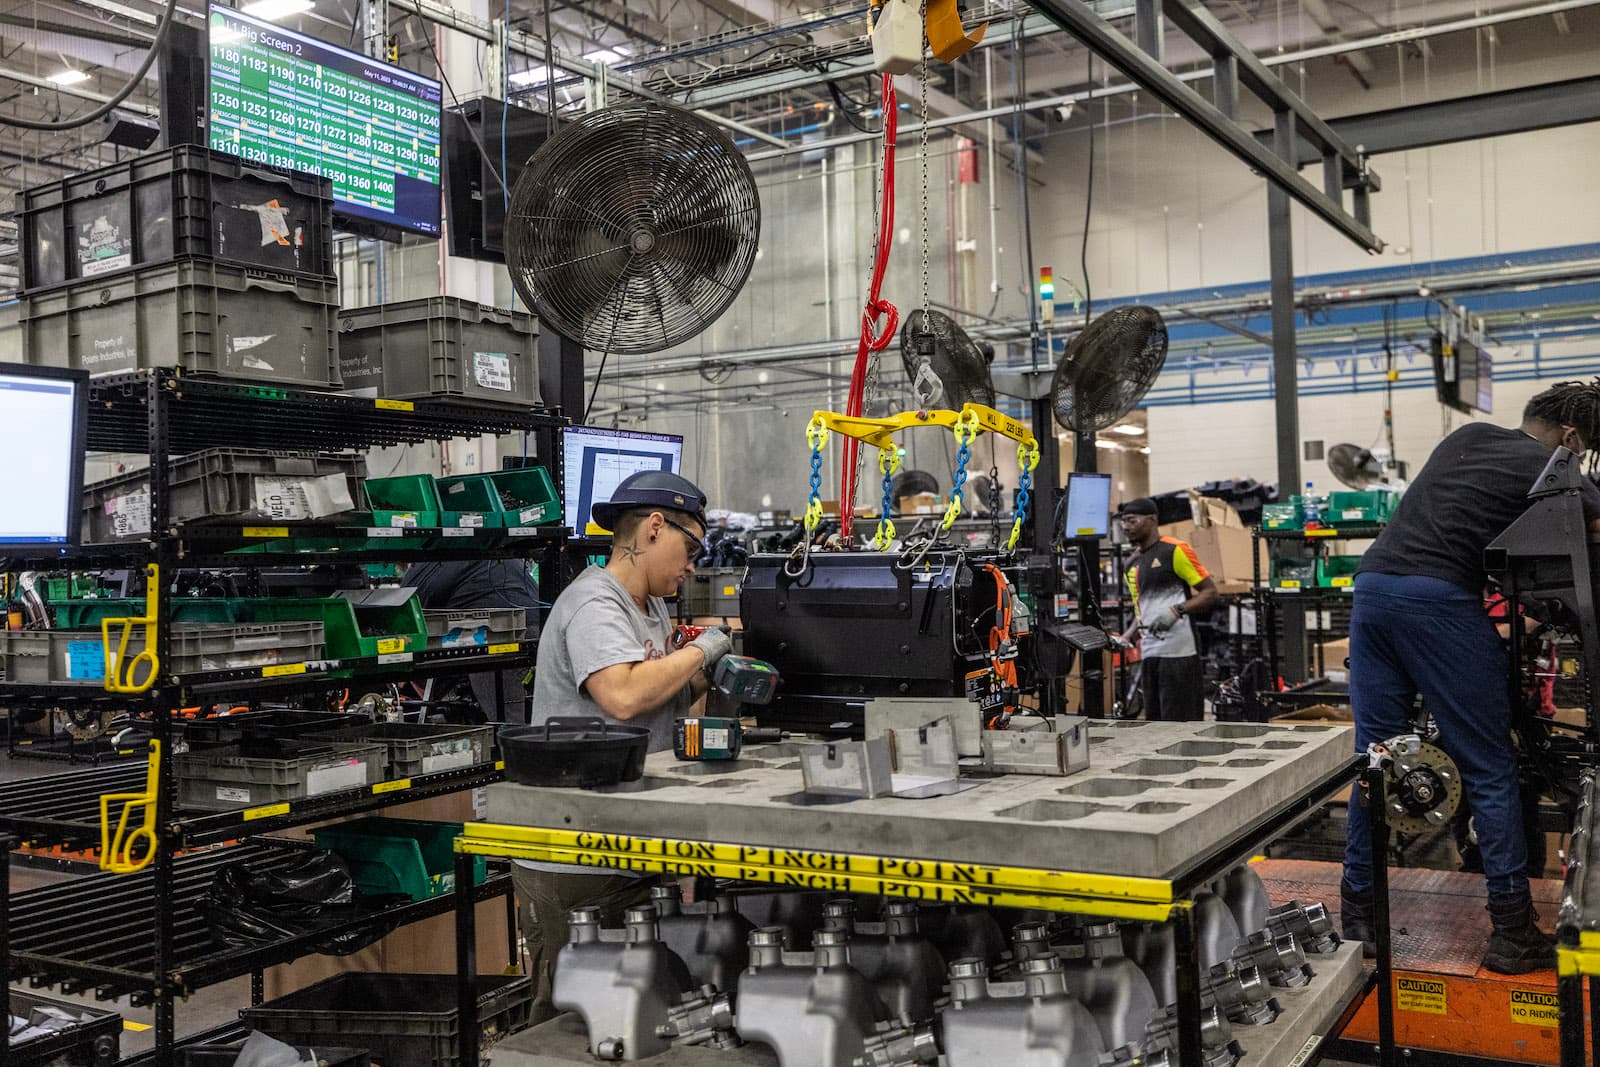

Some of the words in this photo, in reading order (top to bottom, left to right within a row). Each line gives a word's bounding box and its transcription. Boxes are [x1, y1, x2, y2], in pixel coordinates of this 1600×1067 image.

[241, 25, 257, 43] Big
[260, 32, 293, 53] Screen
[295, 44, 302, 56] 2
[213, 46, 239, 63] 1180
[242, 55, 267, 73] 1182
[270, 64, 295, 81] 1190
[297, 73, 321, 89] 1210
[323, 82, 346, 97] 1220
[212, 92, 239, 109] 1250
[348, 90, 371, 106] 1226
[372, 98, 394, 113] 1228
[242, 101, 267, 117] 1252
[396, 105, 417, 120] 1230
[270, 109, 295, 125] 1260
[297, 117, 320, 132] 1270
[419, 113, 439, 128] 1240
[323, 125, 346, 140] 1272
[348, 132, 371, 147] 1280
[212, 138, 239, 155] 1310
[241, 146, 267, 162] 1320
[372, 139, 394, 155] 1282
[396, 146, 417, 161] 1290
[269, 154, 294, 169] 1330
[419, 153, 439, 168] 1300
[296, 161, 320, 176] 1340
[323, 168, 346, 184] 1350
[348, 174, 370, 190] 1360
[373, 180, 393, 193] 1400
[1015, 426, 1023, 438] LBS
[576, 833, 715, 859] CAUTION
[740, 847, 850, 871] PINCH
[879, 857, 1001, 884] POINT
[576, 853, 715, 878] CAUTION
[740, 868, 850, 891] PINCH
[879, 880, 1002, 907] POINT
[1400, 980, 1442, 993] CAUTION
[1512, 992, 1559, 1005] CAUTION
[1512, 1008, 1526, 1016] NO
